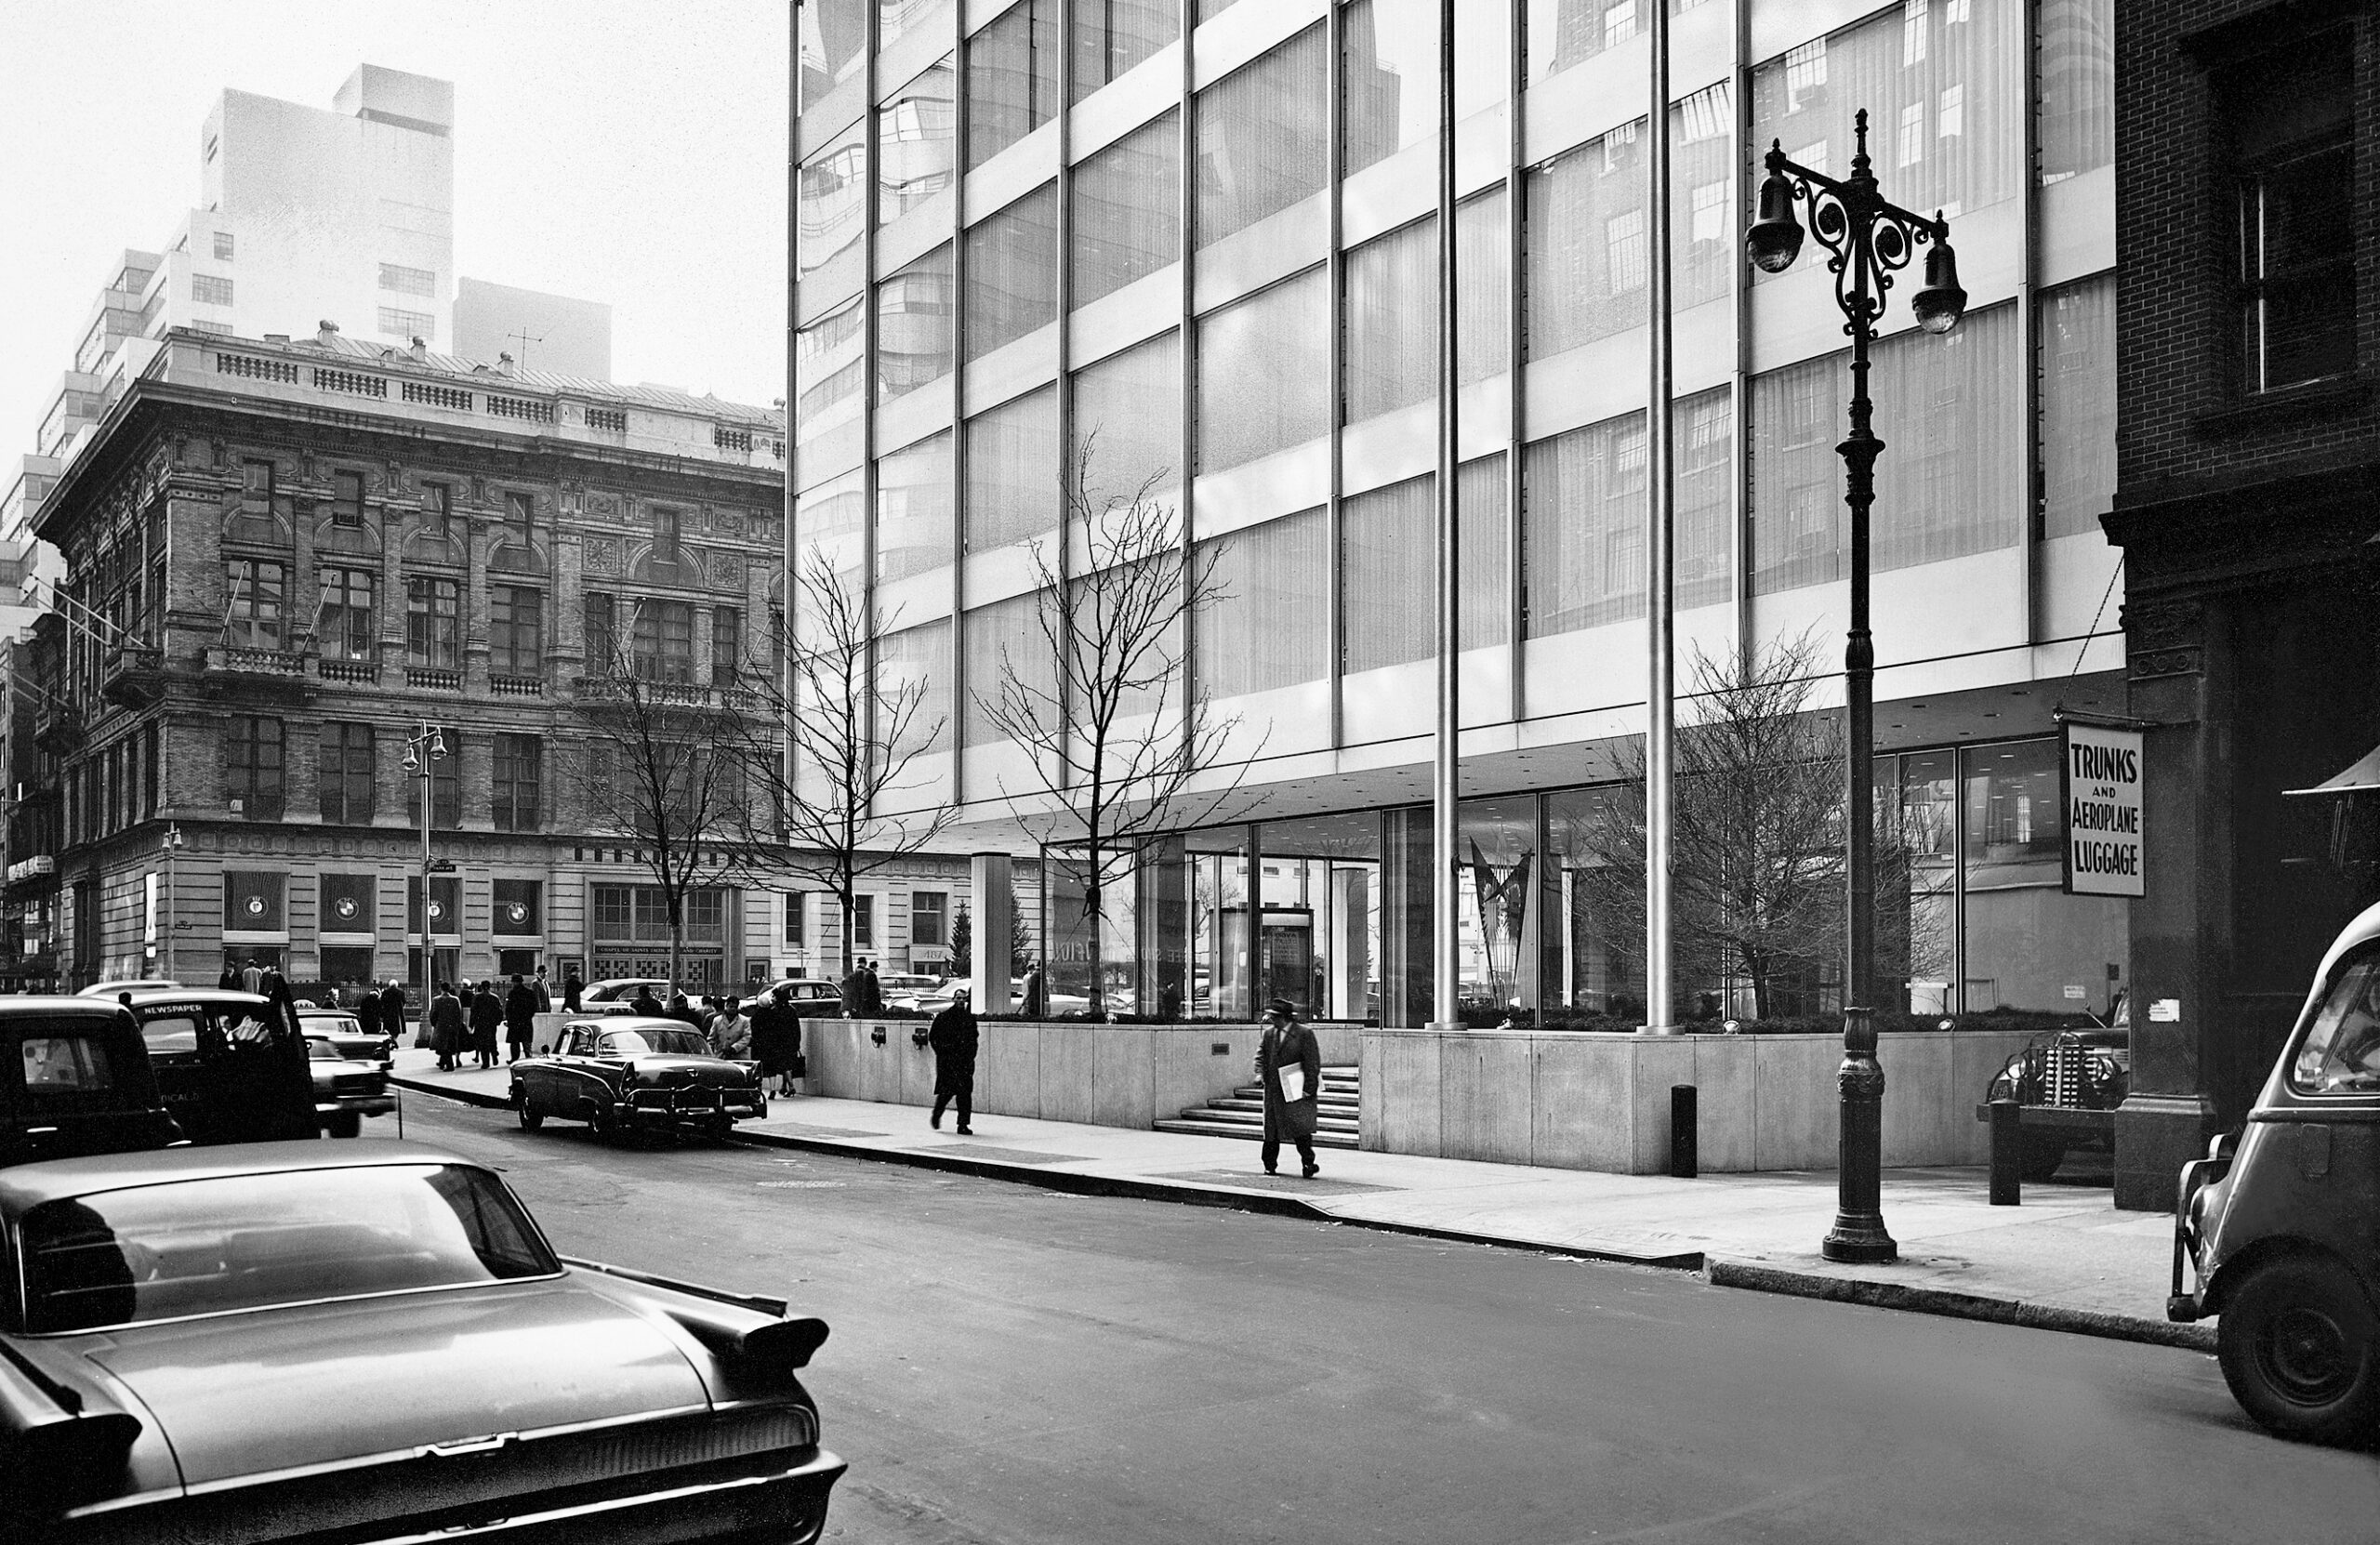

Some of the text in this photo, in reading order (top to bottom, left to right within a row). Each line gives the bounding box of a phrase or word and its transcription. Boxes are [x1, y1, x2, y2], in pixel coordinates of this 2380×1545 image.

[2070, 743, 2137, 784] TRUNKS
[2092, 786, 2116, 799] AND
[2071, 797, 2138, 834] AEROPLANE
[2074, 840, 2137, 876] LUGGAGE
[144, 1004, 202, 1014] NEWSPAPER
